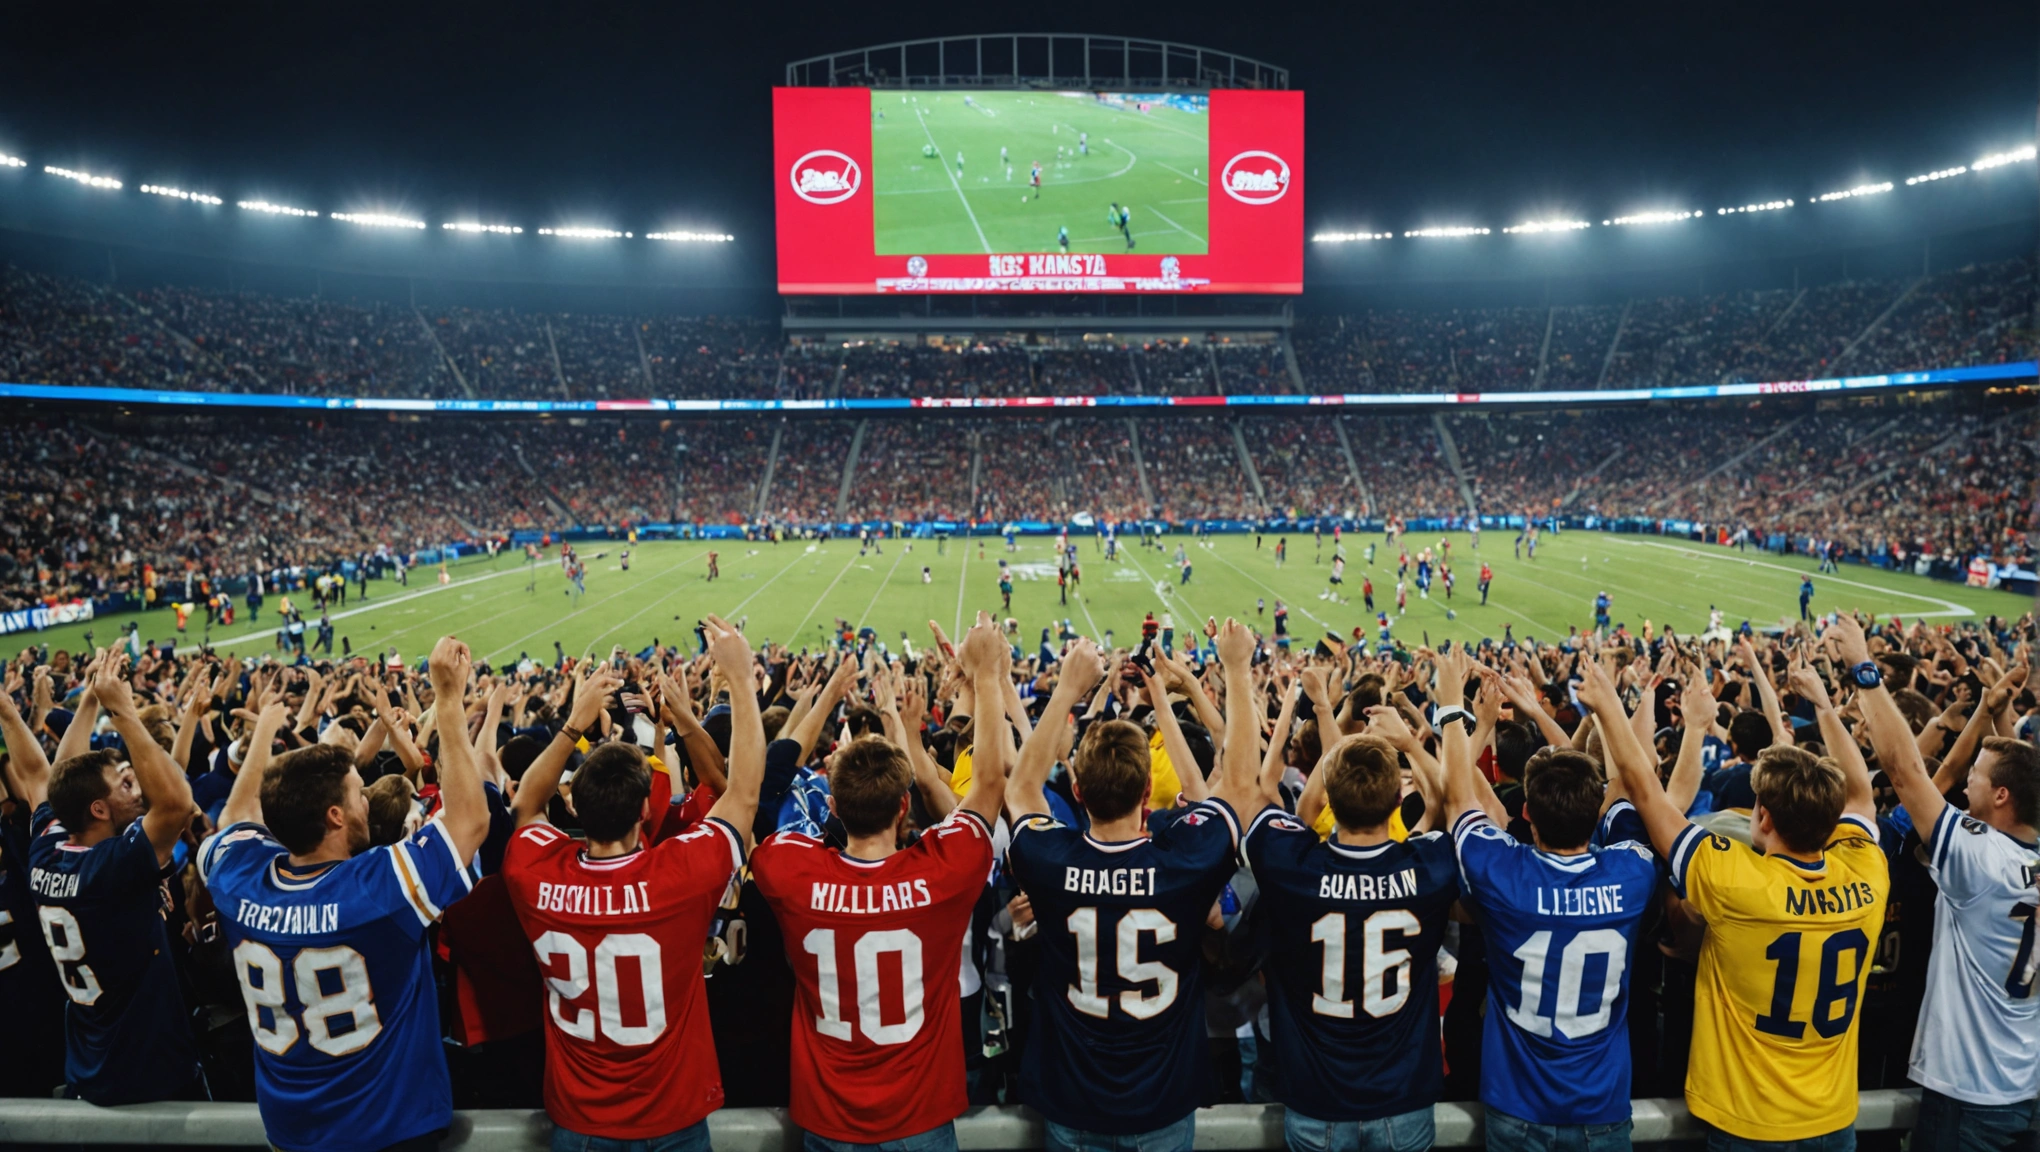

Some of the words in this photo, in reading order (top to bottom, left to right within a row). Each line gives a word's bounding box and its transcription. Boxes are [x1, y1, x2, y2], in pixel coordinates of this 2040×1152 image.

[232, 939, 384, 1057] 88
[532, 929, 668, 1046] 20
[802, 928, 926, 1046] 10
[1310, 908, 1422, 1020] 16
[1506, 928, 1629, 1040] 10
[1754, 927, 1870, 1040] 18
